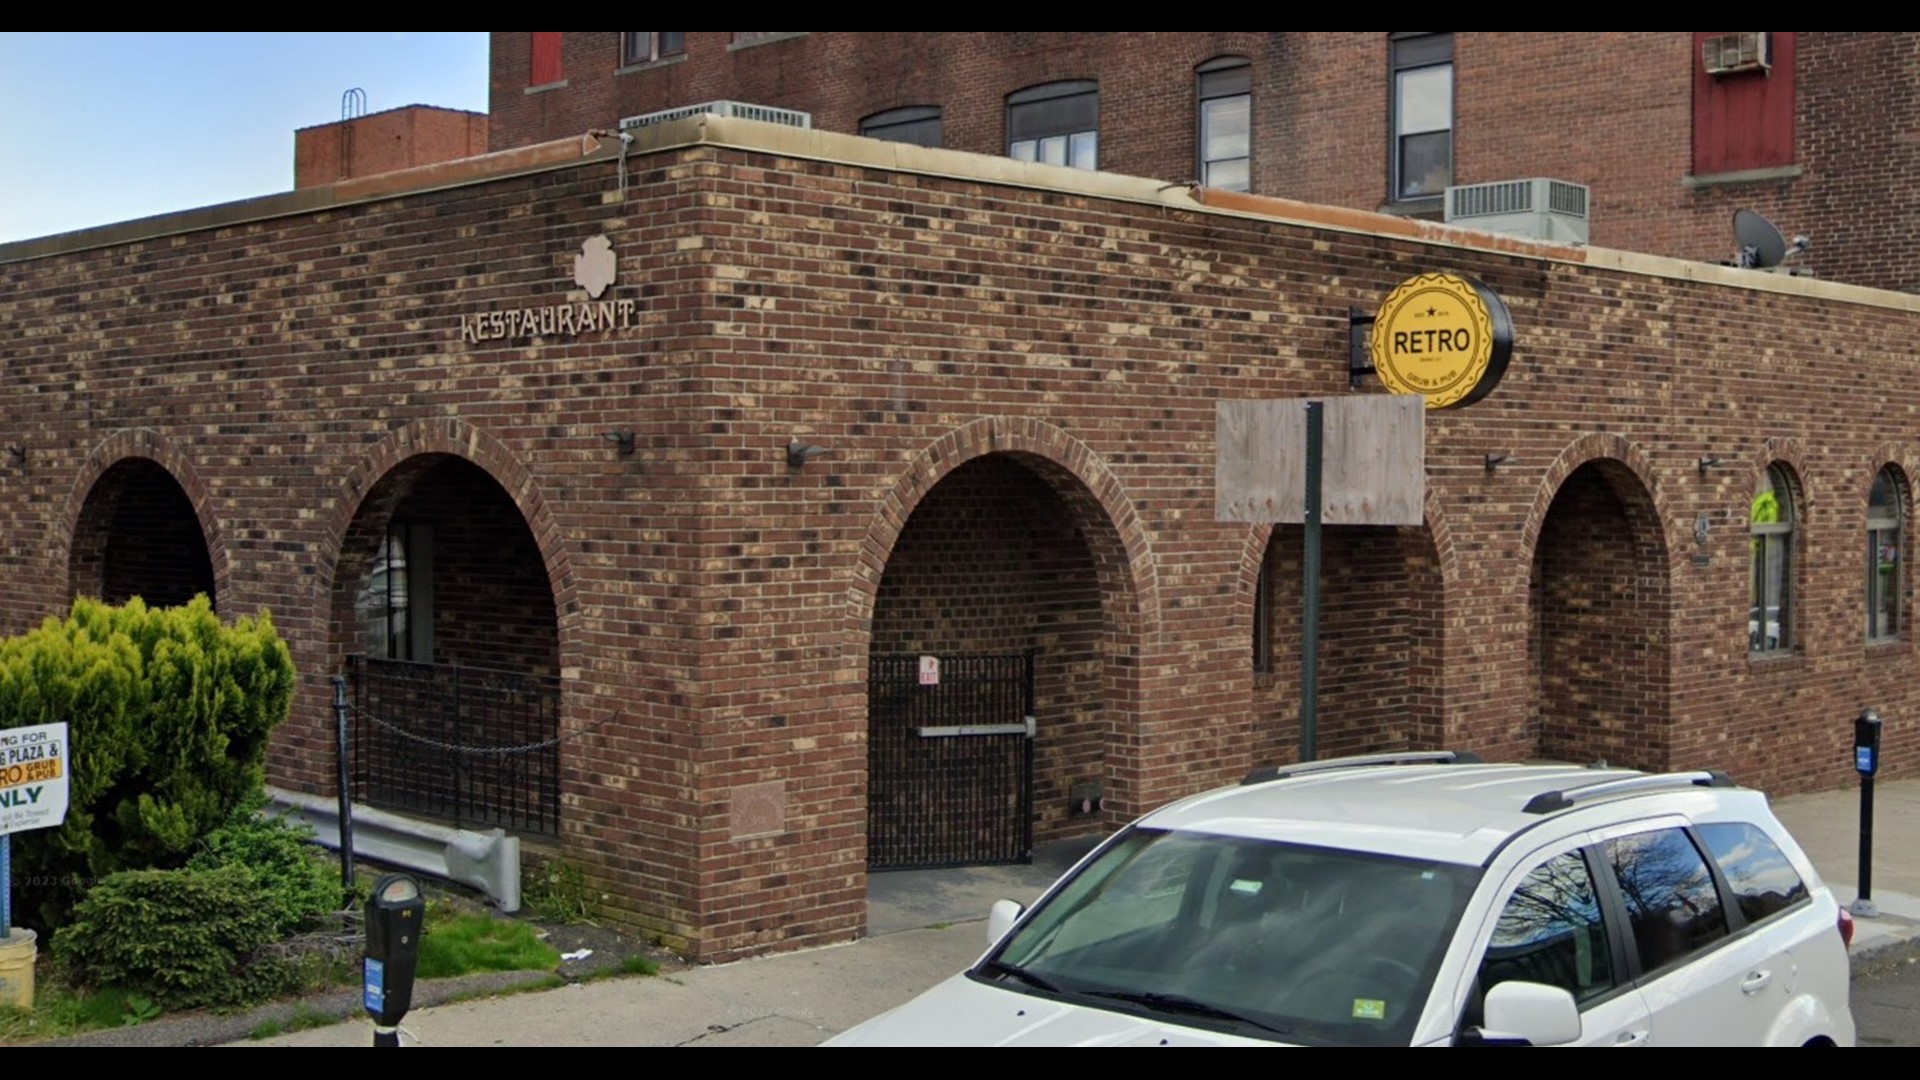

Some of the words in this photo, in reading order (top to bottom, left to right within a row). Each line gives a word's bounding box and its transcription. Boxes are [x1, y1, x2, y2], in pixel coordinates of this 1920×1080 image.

[1394, 328, 1471, 354] RETRO
[1406, 372, 1429, 386] GRUB
[1432, 378, 1438, 386] &
[1440, 370, 1457, 383] PUB
[22, 731, 47, 743] FOR
[9, 745, 44, 763] PLAZA
[49, 743, 58, 757] &
[26, 759, 56, 772] GRUB
[0, 786, 43, 808] NLY
